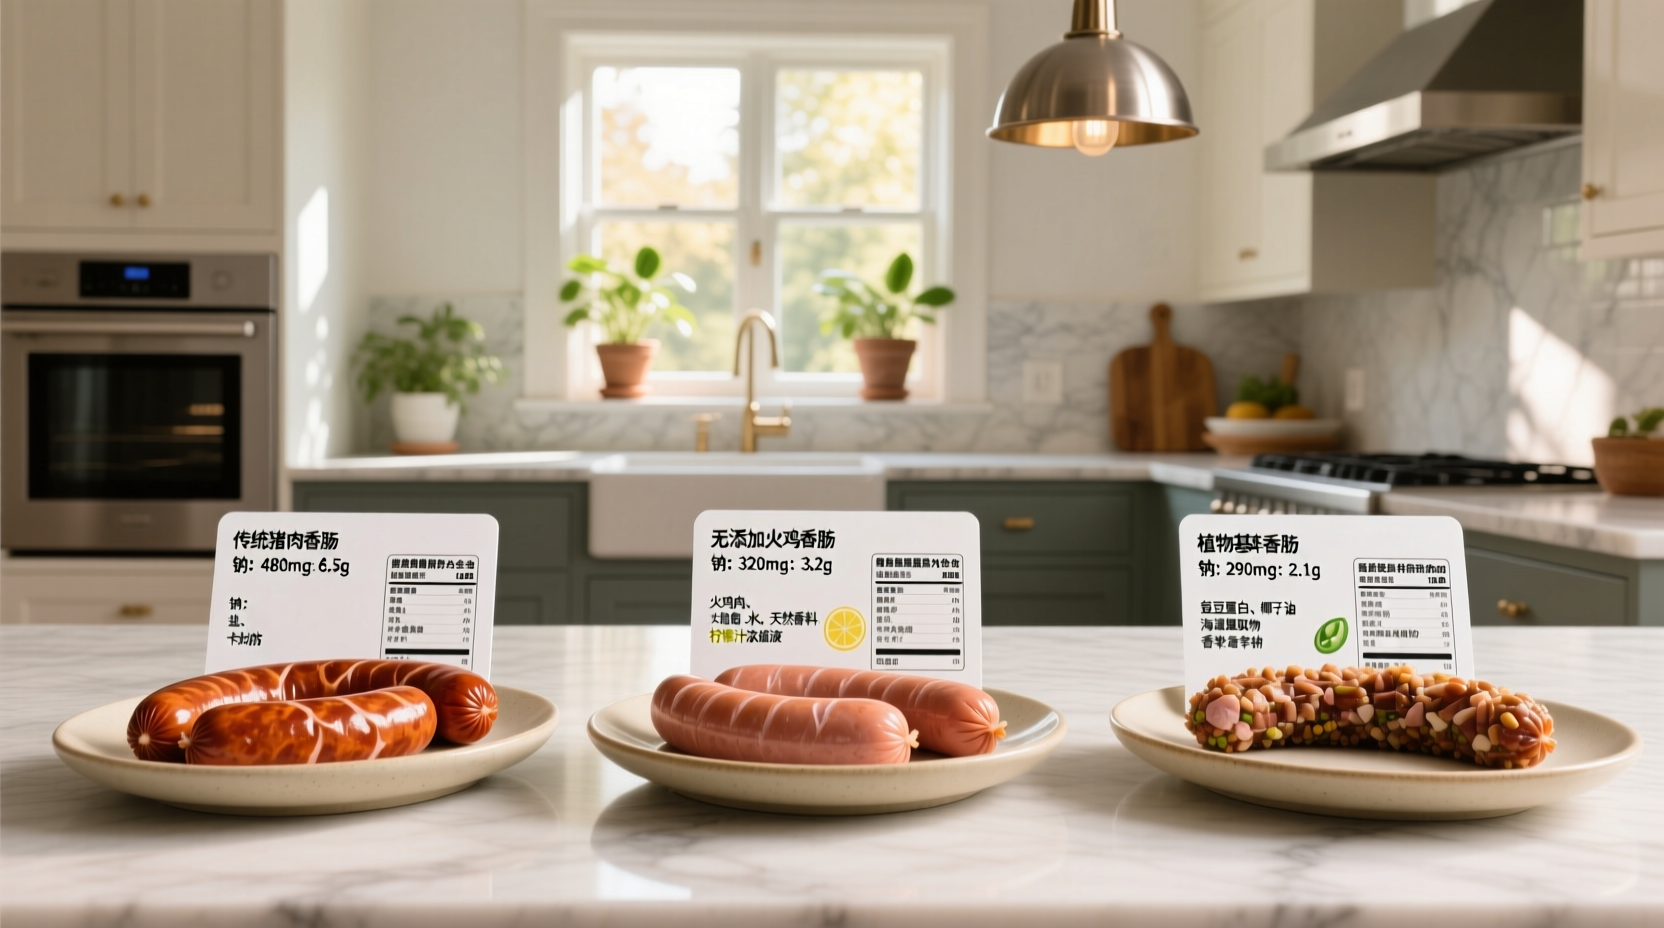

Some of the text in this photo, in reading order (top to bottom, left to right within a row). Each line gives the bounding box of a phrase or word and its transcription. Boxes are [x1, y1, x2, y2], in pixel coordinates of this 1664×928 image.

[233, 529, 340, 551] 传统猪肉香肠
[711, 528, 836, 550] 无添加火鸡香肠
[318, 557, 350, 578] 6.5g
[800, 556, 833, 576] 3.2g
[1288, 562, 1321, 581] 2.1g
